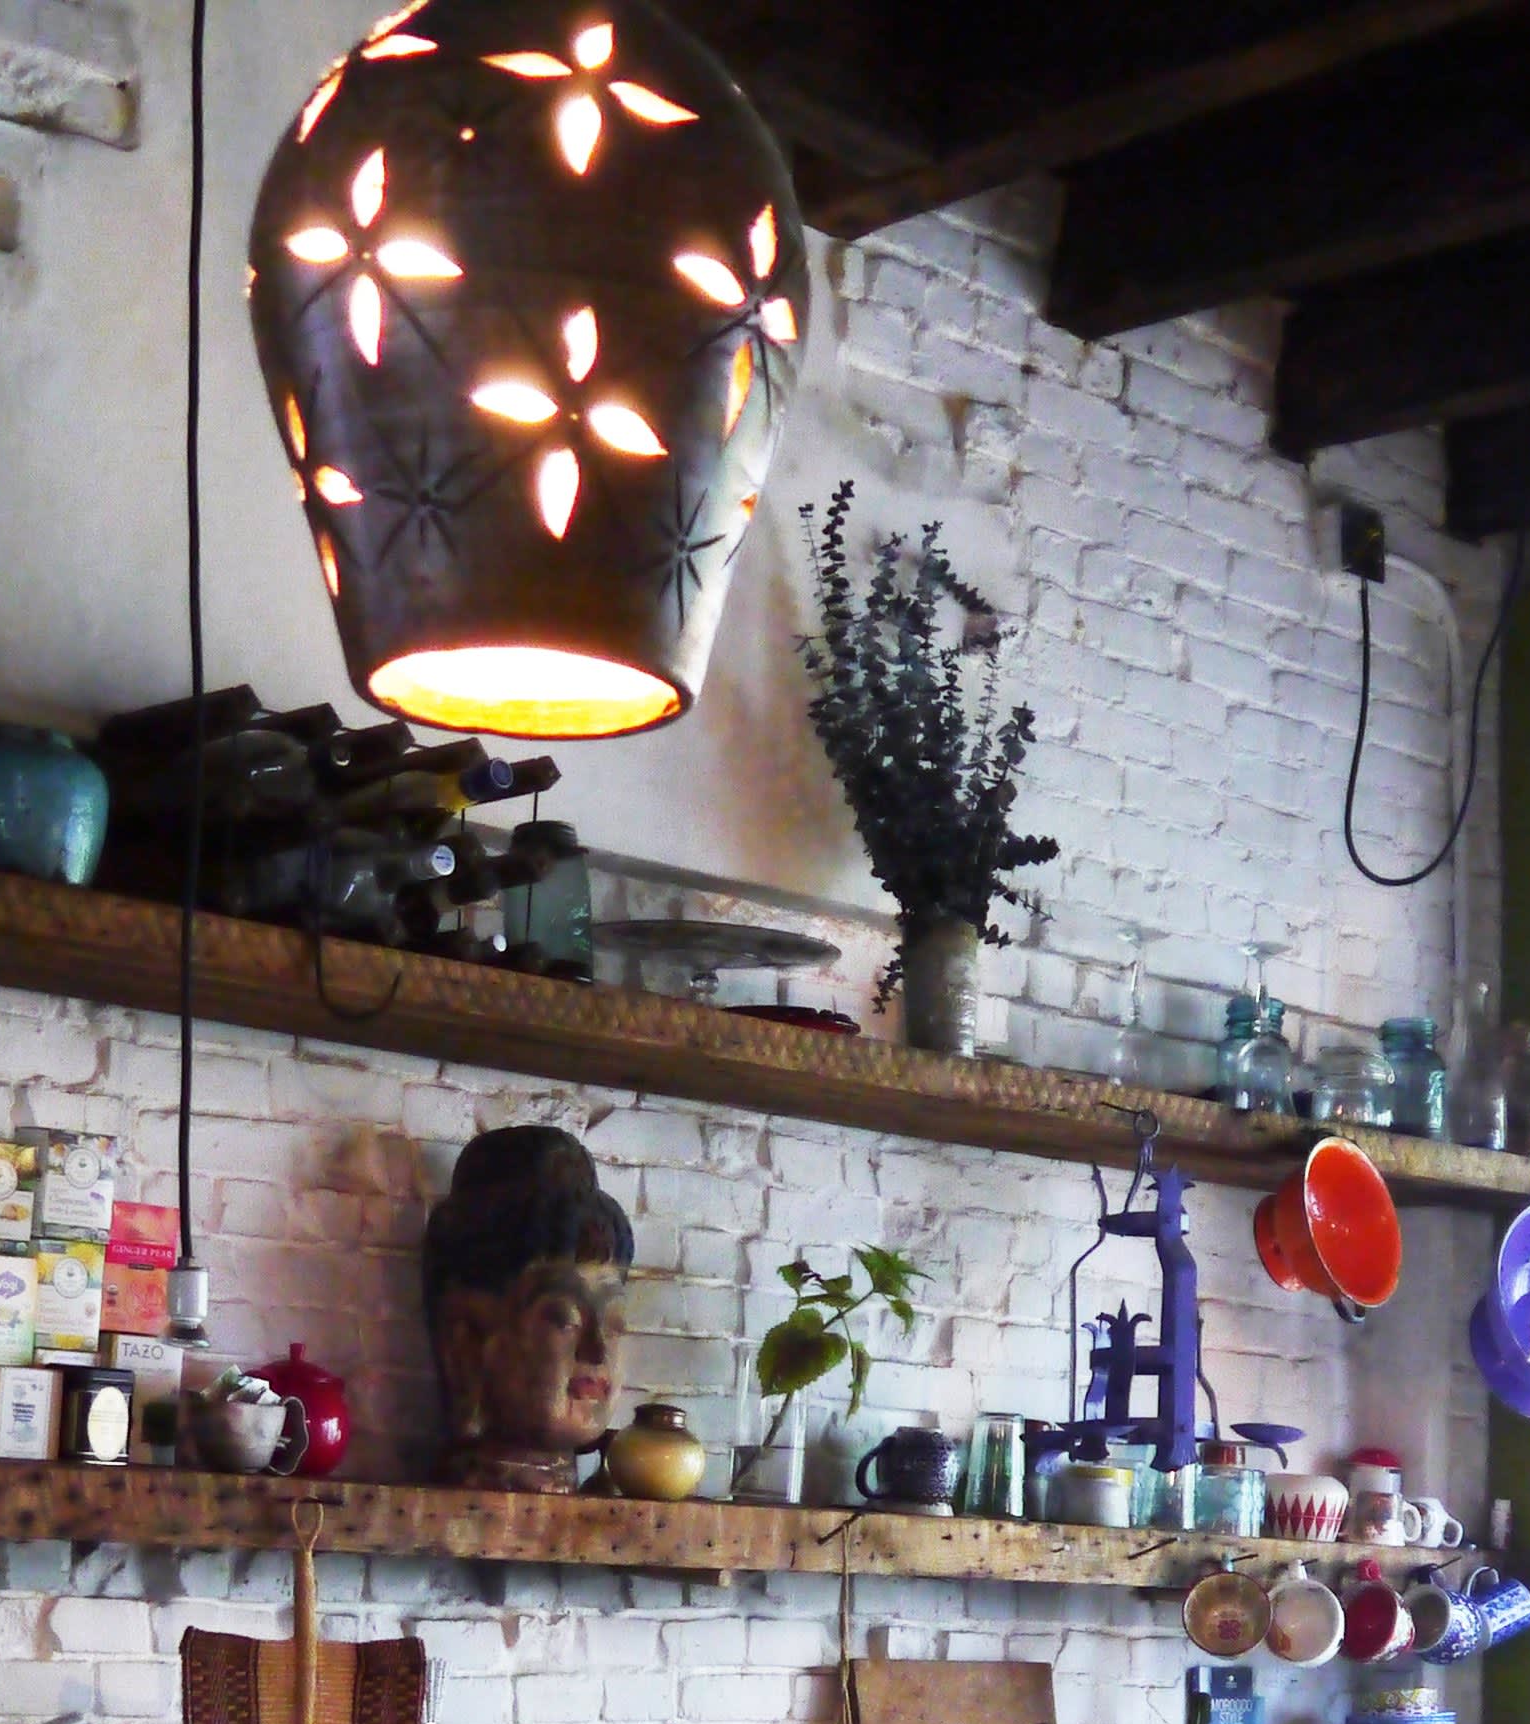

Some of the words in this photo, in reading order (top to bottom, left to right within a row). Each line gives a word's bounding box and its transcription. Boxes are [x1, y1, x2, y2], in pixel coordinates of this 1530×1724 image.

[111, 1244, 148, 1256] GINGER
[149, 1247, 173, 1258] PEAR
[121, 1341, 164, 1360] TAZO
[1211, 1698, 1254, 1713] MOROCCO
